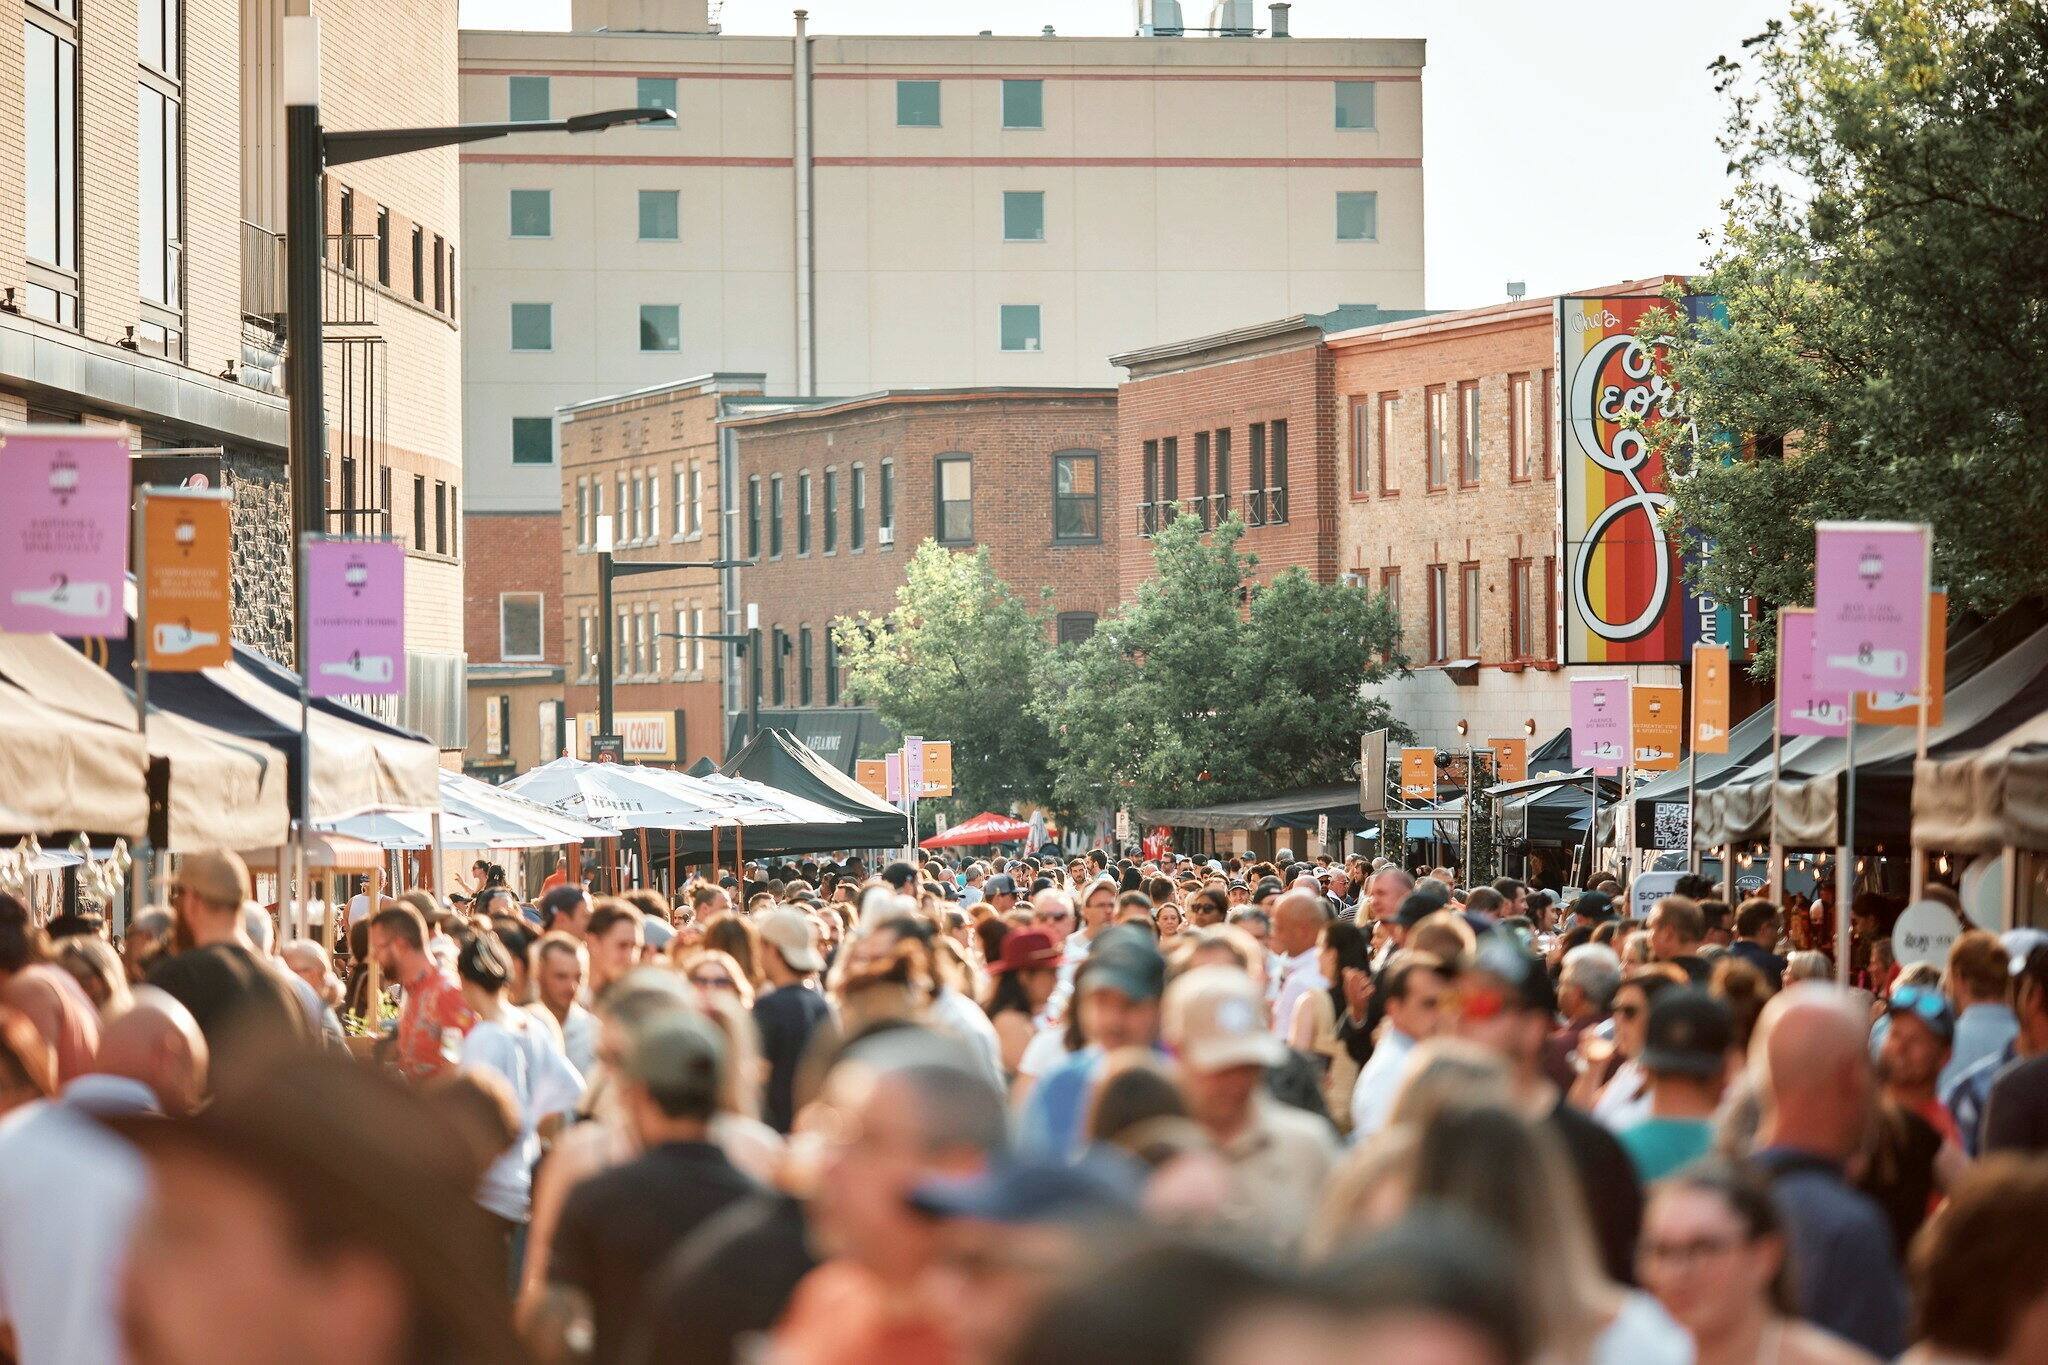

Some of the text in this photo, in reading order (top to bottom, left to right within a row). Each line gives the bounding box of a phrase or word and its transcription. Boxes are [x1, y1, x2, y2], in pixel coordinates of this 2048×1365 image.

[1571, 309, 1621, 335] Chez
[1553, 316, 1563, 647] RESTAURANT
[49, 574, 70, 603] 2
[347, 648, 361, 672] 4
[1857, 640, 1875, 665] 8
[1806, 698, 1831, 718] 10
[630, 720, 664, 750] COUTU
[1593, 741, 1611, 754] 12
[1646, 744, 1662, 757] 13
